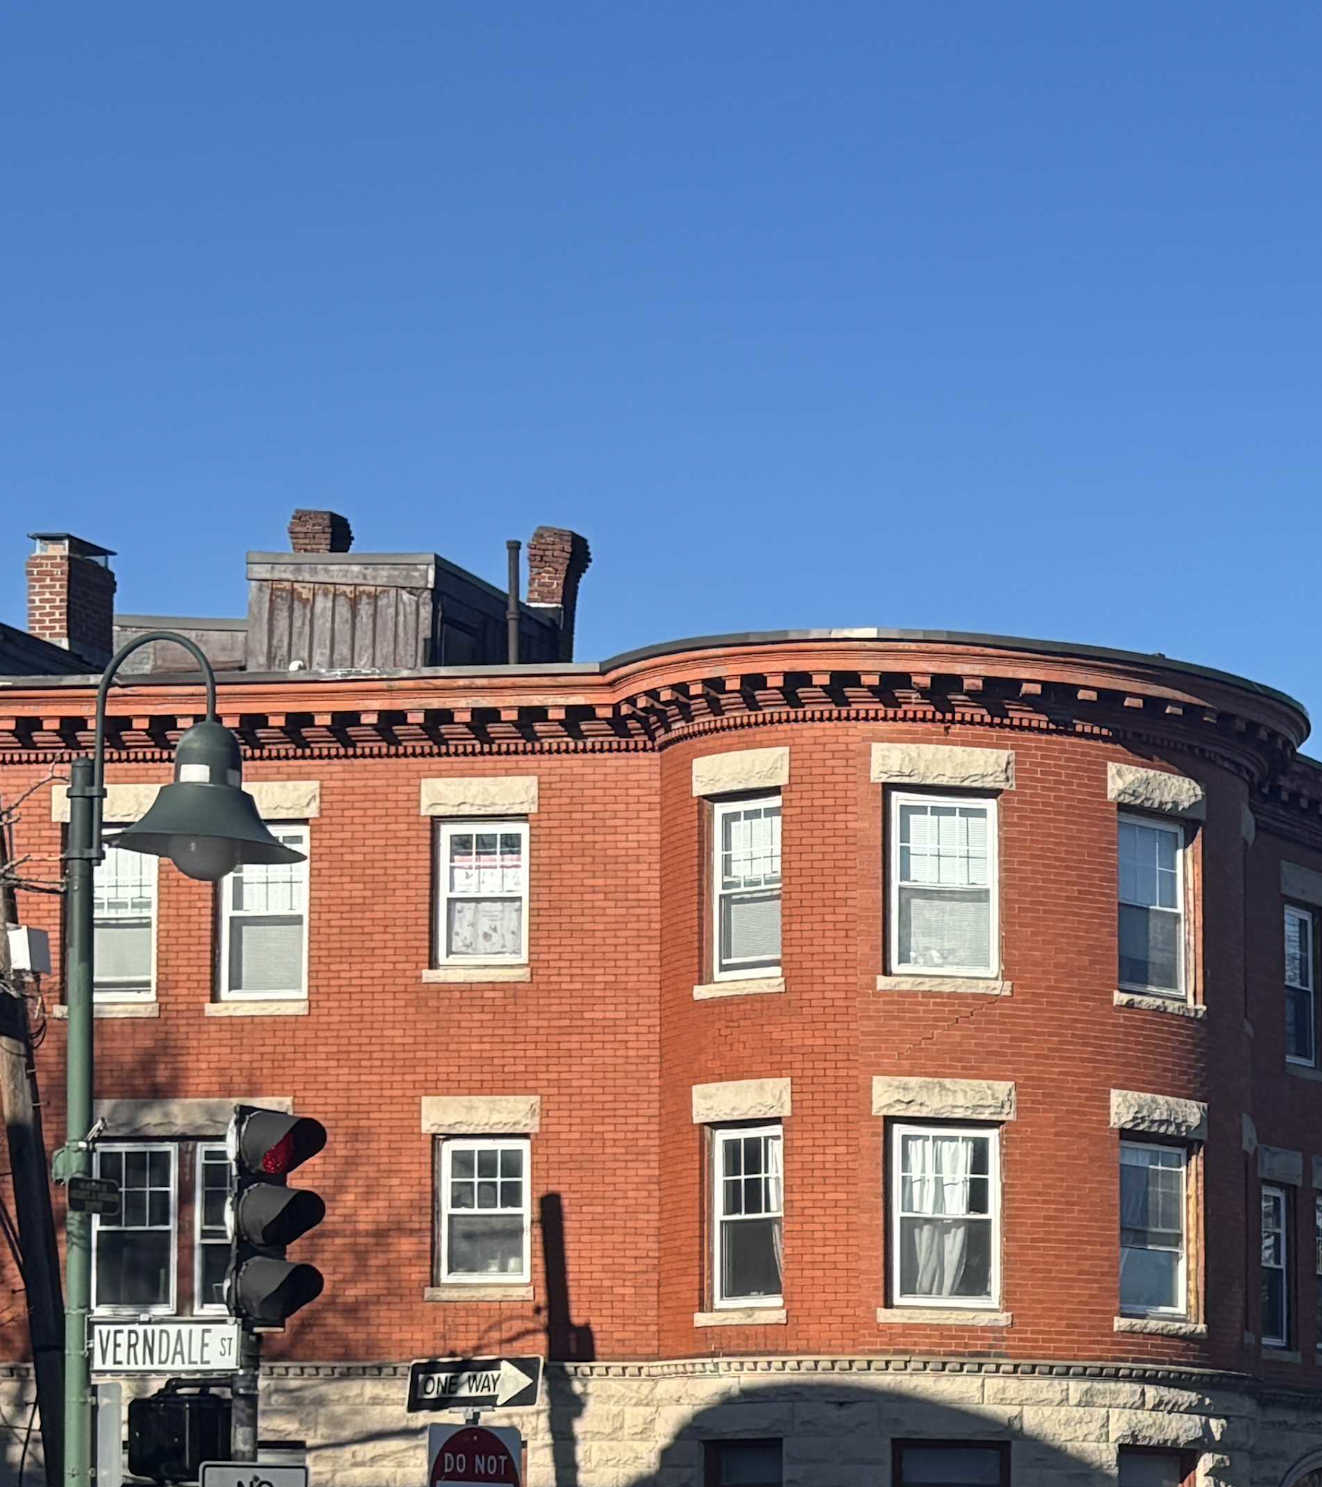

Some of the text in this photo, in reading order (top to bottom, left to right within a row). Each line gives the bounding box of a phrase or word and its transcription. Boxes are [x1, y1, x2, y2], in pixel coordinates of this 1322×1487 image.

[98, 1328, 233, 1365] VERNDALE ST
[423, 1373, 501, 1396] ONE WAY
[444, 1453, 509, 1476] DO NOT
